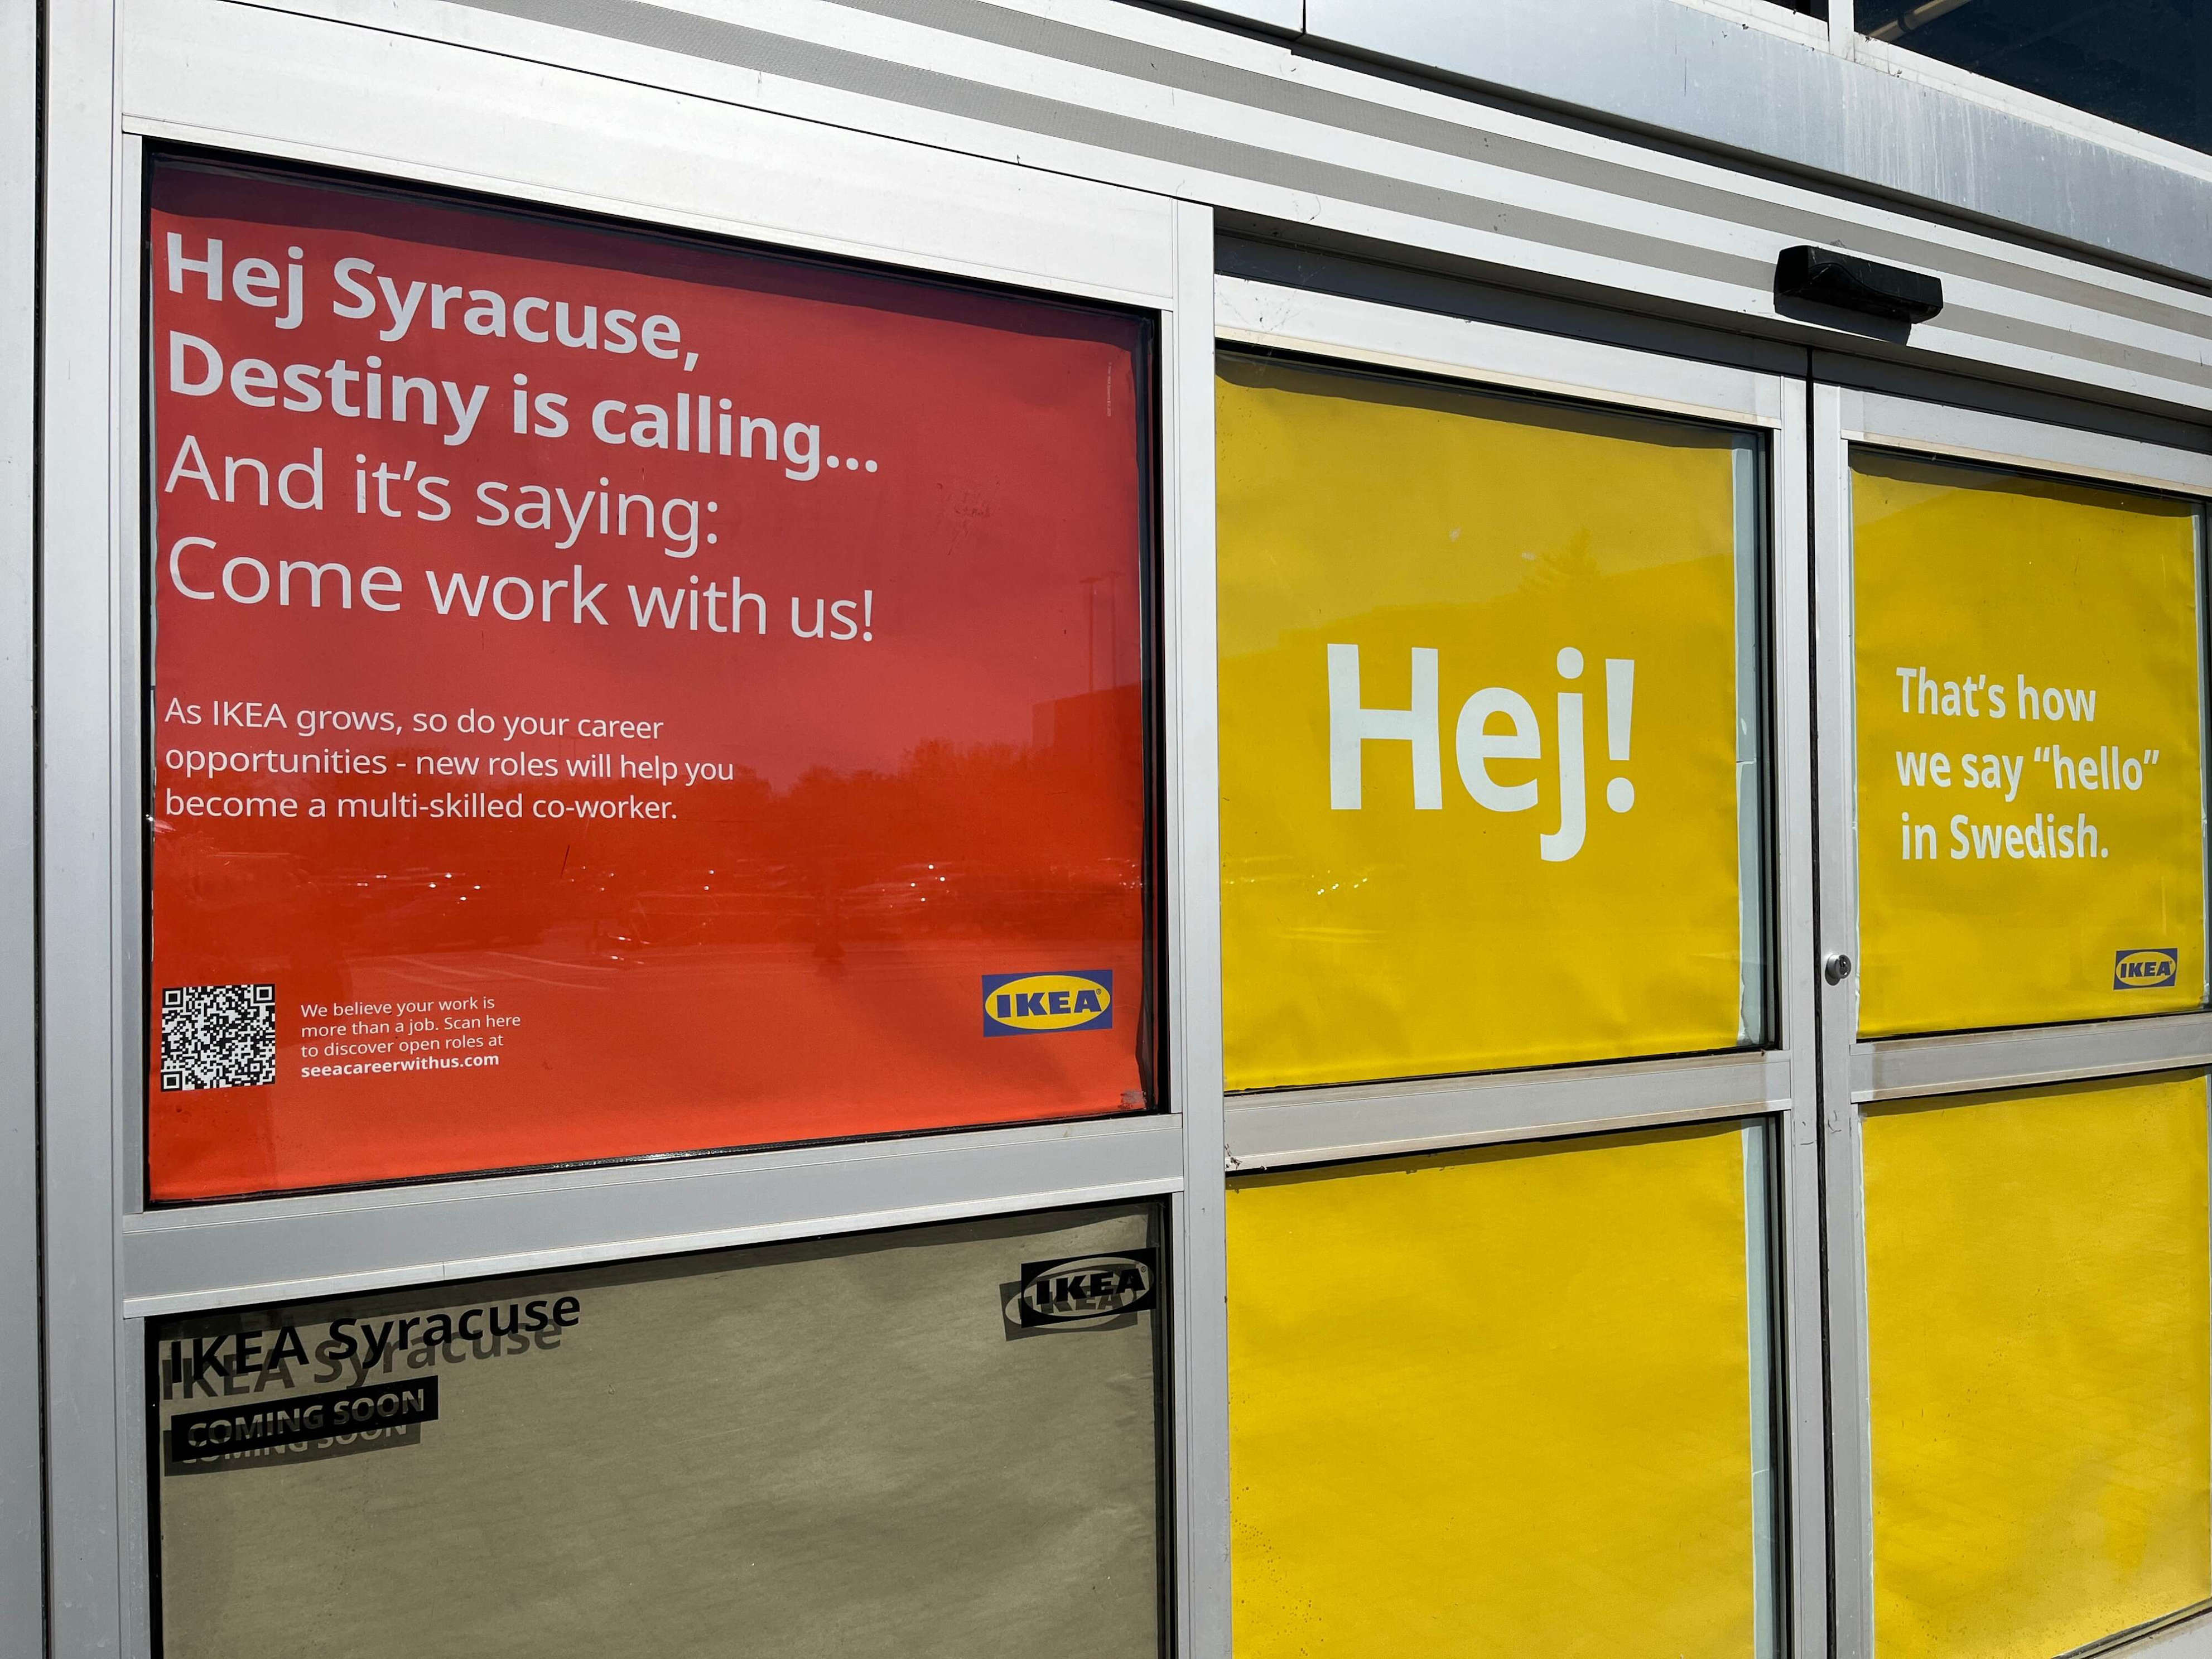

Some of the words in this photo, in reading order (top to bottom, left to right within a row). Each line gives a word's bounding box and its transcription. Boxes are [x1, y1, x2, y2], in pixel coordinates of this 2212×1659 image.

[167, 232, 303, 329] Hej
[333, 258, 698, 372] Syracuse,
[170, 330, 489, 446] Destiny
[514, 374, 568, 437] is
[592, 393, 877, 482] calling...
[165, 435, 322, 510] And
[356, 454, 451, 521] it’s
[477, 477, 717, 558] saying:
[170, 537, 402, 611] Come
[426, 565, 608, 625] work
[628, 575, 765, 634] with
[792, 590, 872, 642] us!
[165, 698, 201, 724] As
[214, 701, 287, 728] IKEA
[297, 711, 402, 736] grows,
[413, 713, 447, 732] so
[458, 708, 494, 733] do
[503, 716, 569, 741] your
[579, 720, 663, 739] career
[1896, 667, 2006, 718] That’s
[2018, 674, 2096, 721] how
[166, 749, 387, 778] opportunities
[417, 756, 479, 775] new
[490, 751, 558, 776] roles
[566, 754, 610, 777] will
[621, 755, 677, 785] help
[685, 763, 732, 786] you
[1328, 644, 1635, 861] Hej!
[1896, 751, 1951, 787] we
[1962, 754, 2023, 802] say
[2035, 745, 2159, 790] “hello”
[167, 788, 297, 817] become
[309, 799, 325, 817] a
[339, 792, 522, 817] multi-skilled
[533, 795, 676, 818] co-worker.
[1902, 812, 1936, 859] in
[1951, 813, 2108, 859] Swedish.
[301, 1005, 327, 1017] We
[334, 1002, 392, 1016] believe
[397, 1002, 434, 1016] your
[439, 997, 478, 1010] work
[484, 997, 494, 1009] is
[302, 1026, 346, 1037] more
[351, 1021, 389, 1034] than
[396, 1023, 403, 1032] a
[408, 1018, 438, 1035] job.
[445, 1017, 480, 1029] Scan
[486, 1015, 521, 1027] here
[301, 1046, 318, 1057] to
[325, 1043, 394, 1056] discover
[399, 1037, 439, 1054] open
[446, 1035, 483, 1049] roles
[489, 1035, 503, 1046] at
[302, 1053, 498, 1077] seeacareerwithus.com
[171, 1325, 309, 1384] IKEA
[329, 1295, 581, 1369] Syracuse
[187, 1404, 324, 1448] COMING
[334, 1388, 425, 1426] SOON
